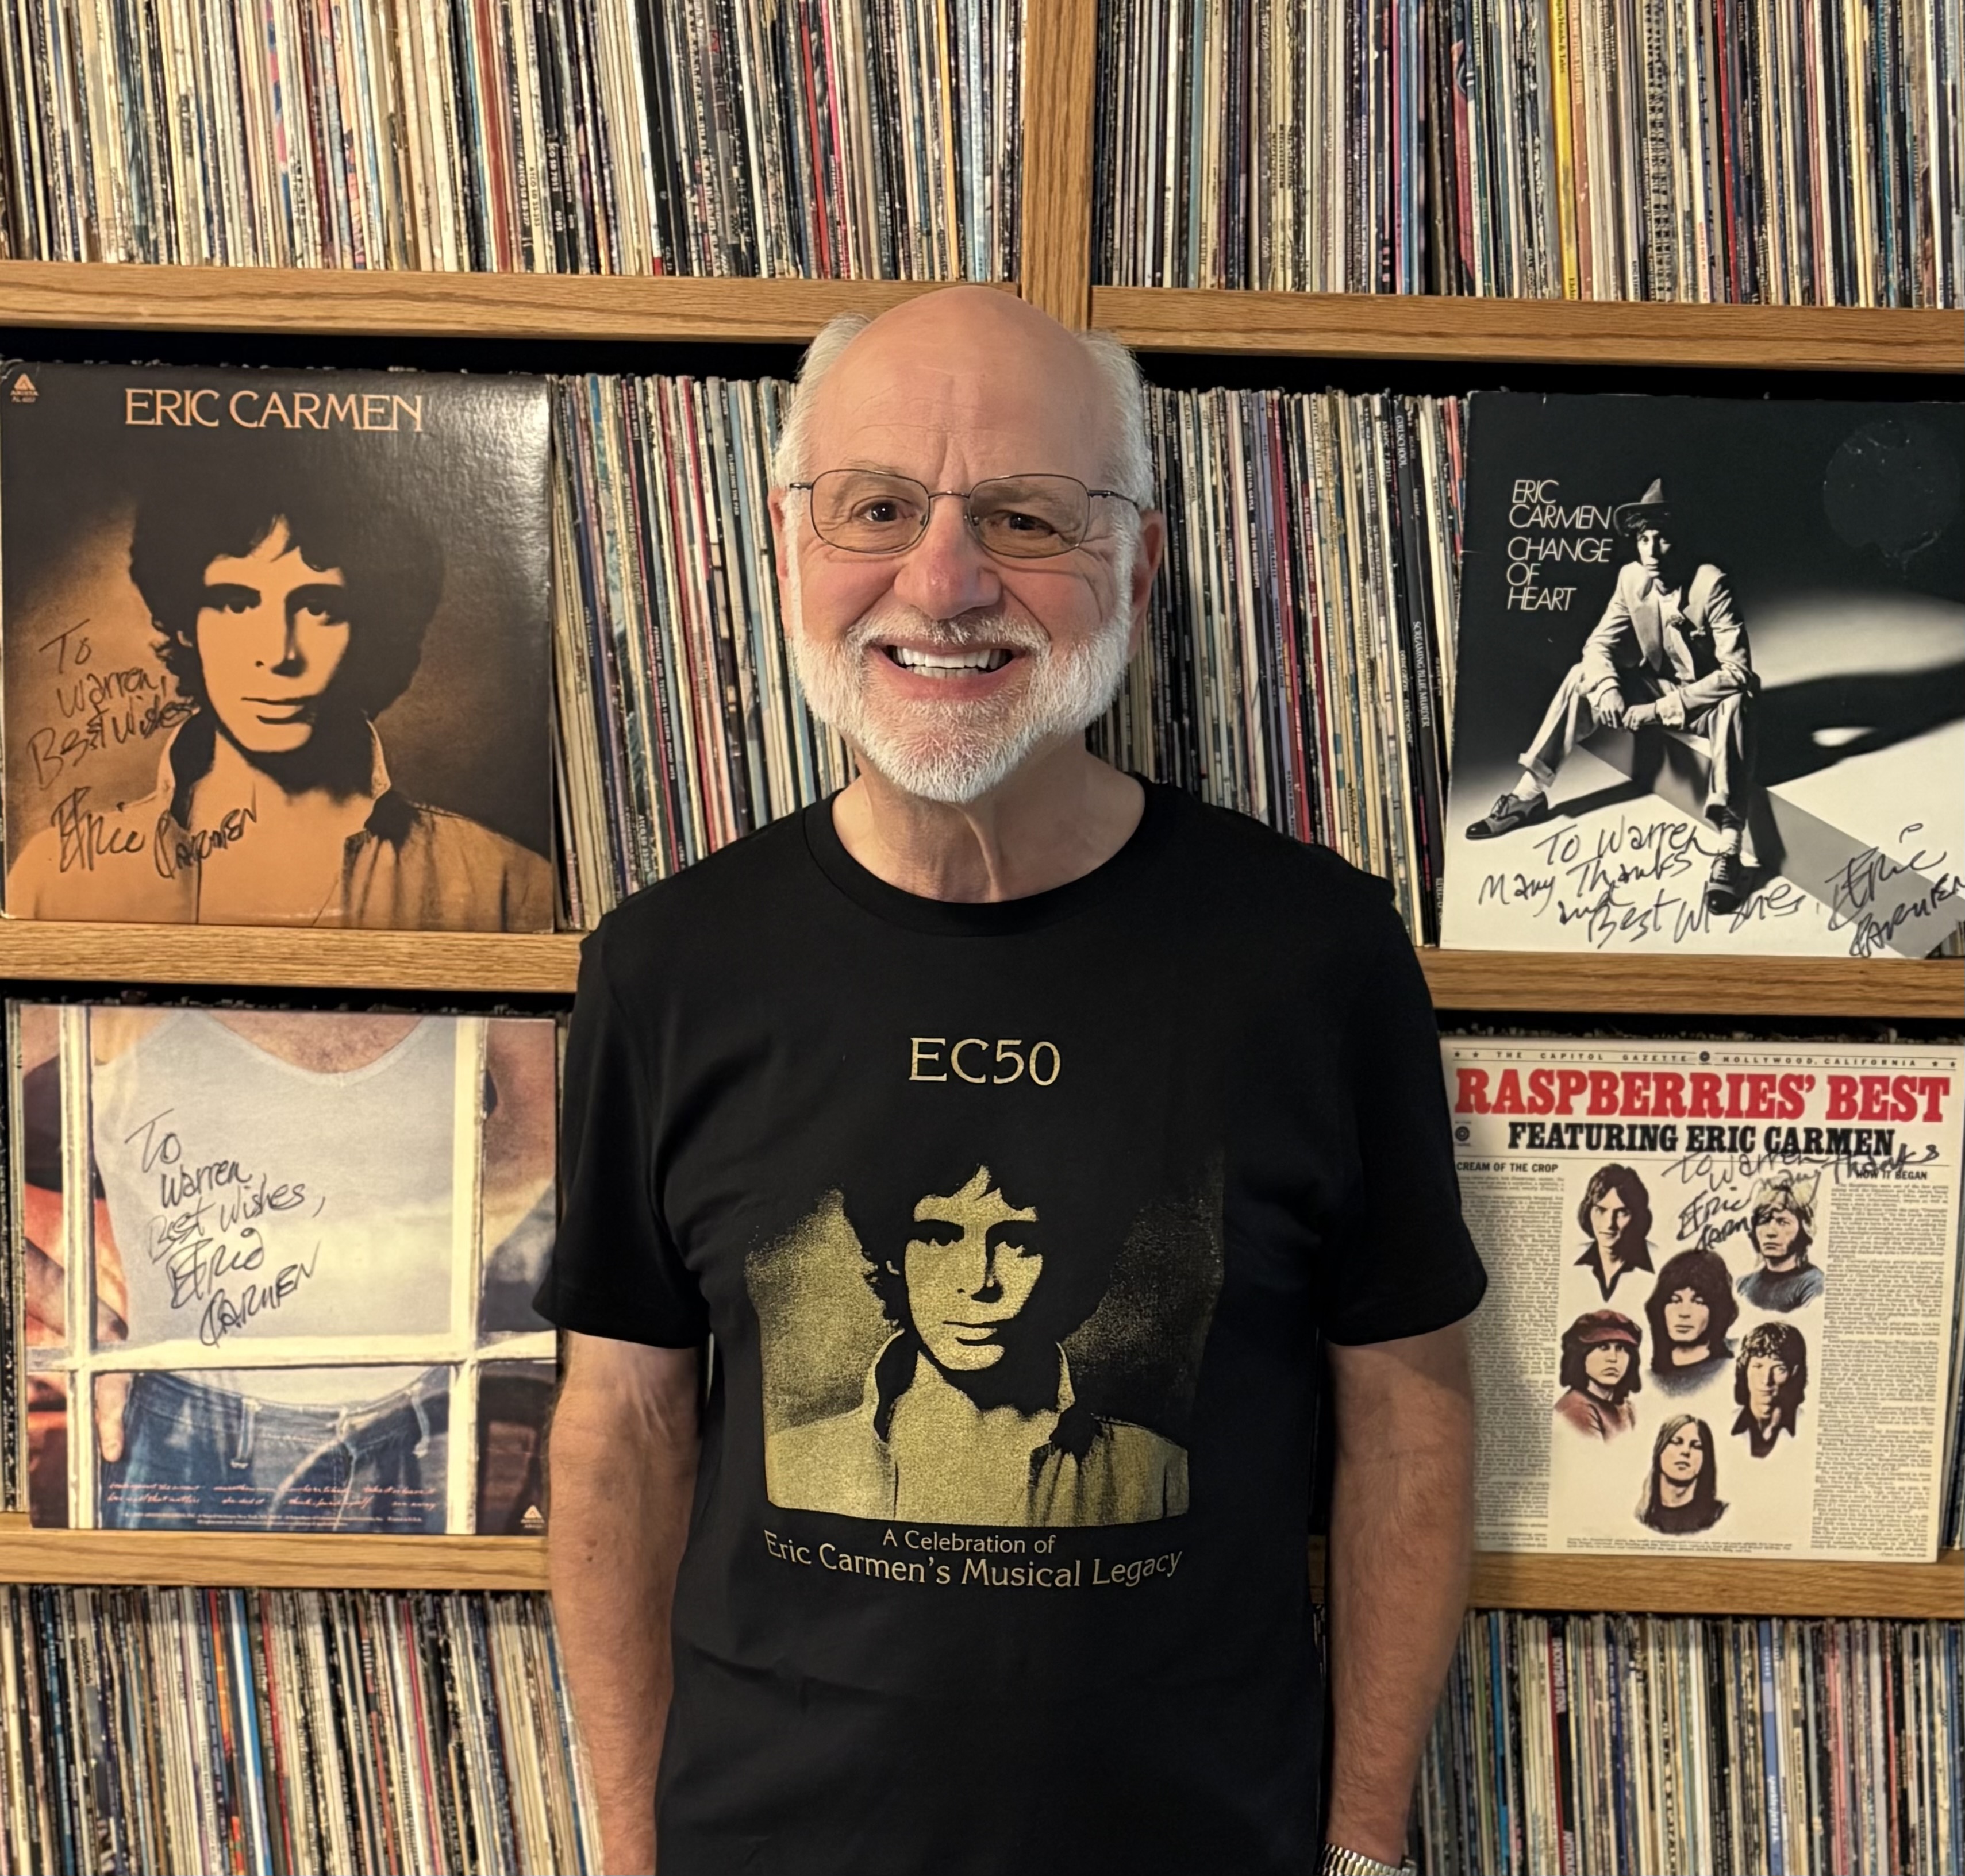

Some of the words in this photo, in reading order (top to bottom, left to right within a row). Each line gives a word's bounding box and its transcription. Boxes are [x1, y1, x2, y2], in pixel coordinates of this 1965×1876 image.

[125, 388, 220, 427] ERIC
[230, 390, 424, 432] CARMEN
[1394, 415, 1408, 468] GIRLSCHOOL
[1512, 479, 1559, 503] ERIC
[1509, 504, 1612, 529] CARMEN
[1508, 536, 1613, 562] CHANGE
[1506, 562, 1541, 586] OF
[1507, 587, 1578, 611] HEART
[653, 625, 662, 660] FERRANTE
[1413, 621, 1426, 668] SCREAMING
[659, 679, 667, 707] TEICHER
[1417, 669, 1428, 691] BLUE
[1418, 692, 1431, 727] MURDER
[662, 712, 671, 739] GOLDEN
[665, 742, 673, 762] PIANO
[1479, 873, 1556, 918] Many
[1588, 888, 1682, 949] Best
[909, 1037, 1061, 1086] EC50
[1496, 1051, 1524, 1060] THE
[1540, 1052, 1605, 1061] CAPITOL
[1622, 1054, 1687, 1062] GAZETTE
[1824, 1057, 1917, 1067] CALIFORNIA
[1454, 1067, 1817, 1120] RASPBERRIES'
[1825, 1074, 1952, 1123] BEST
[1508, 1121, 1679, 1153] FEATURING
[1685, 1124, 1756, 1154] ERIC
[1763, 1126, 1895, 1157] CARMEN
[1456, 1162, 1490, 1172] CREAM
[1493, 1162, 1506, 1172] OF
[1509, 1162, 1528, 1172] THE
[1532, 1164, 1559, 1173] CROP
[1882, 1170, 1892, 1180] IT
[1895, 1170, 1928, 1180] BEGAN
[882, 1528, 898, 1547] A
[905, 1530, 1026, 1554] Celebration
[1033, 1535, 1057, 1554] of
[764, 1528, 812, 1565] Eric
[818, 1542, 951, 1585] Carmen's
[961, 1558, 1081, 1588] Musical
[1091, 1550, 1183, 1588] Legacy
[79, 1637, 93, 1684] woodstock
[1552, 1637, 1566, 1688] SHOOTING
[1555, 1689, 1567, 1713] STAR
